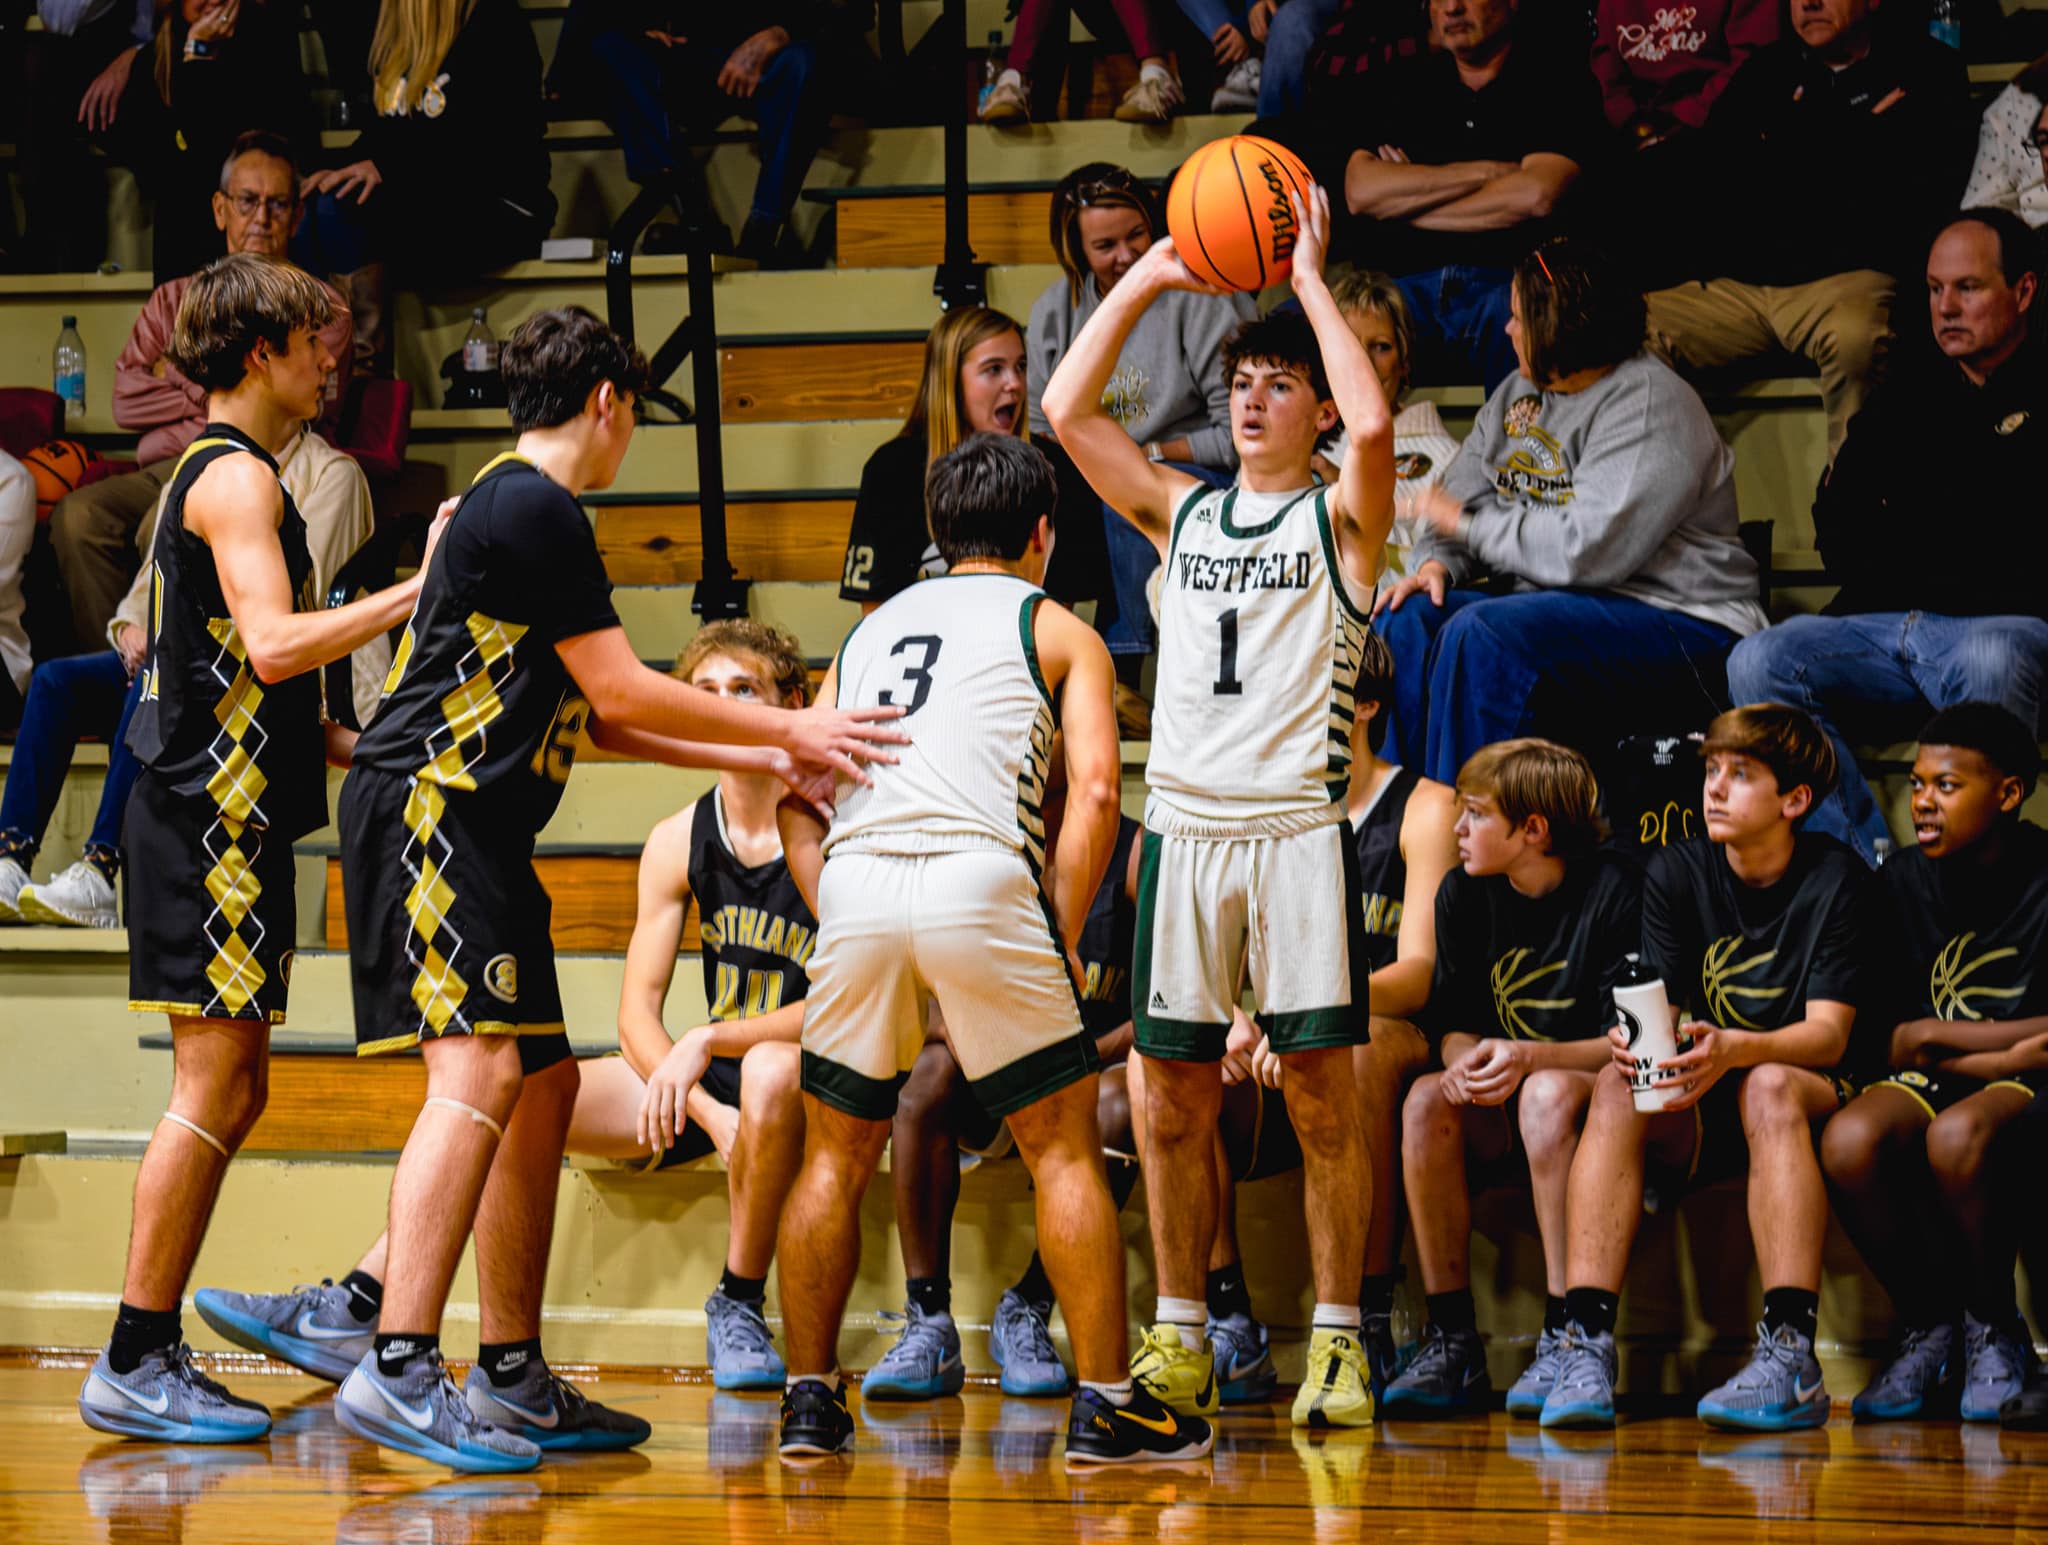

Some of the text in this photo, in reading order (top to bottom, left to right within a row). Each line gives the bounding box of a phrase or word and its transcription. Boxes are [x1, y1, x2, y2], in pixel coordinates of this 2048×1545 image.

[1258, 156, 1296, 265] Wilson
[843, 545, 875, 591] 12
[1179, 551, 1311, 593] WESTFIELD
[878, 635, 943, 716] 3
[1213, 607, 1243, 695] 1
[388, 1338, 416, 1353] NIKE
